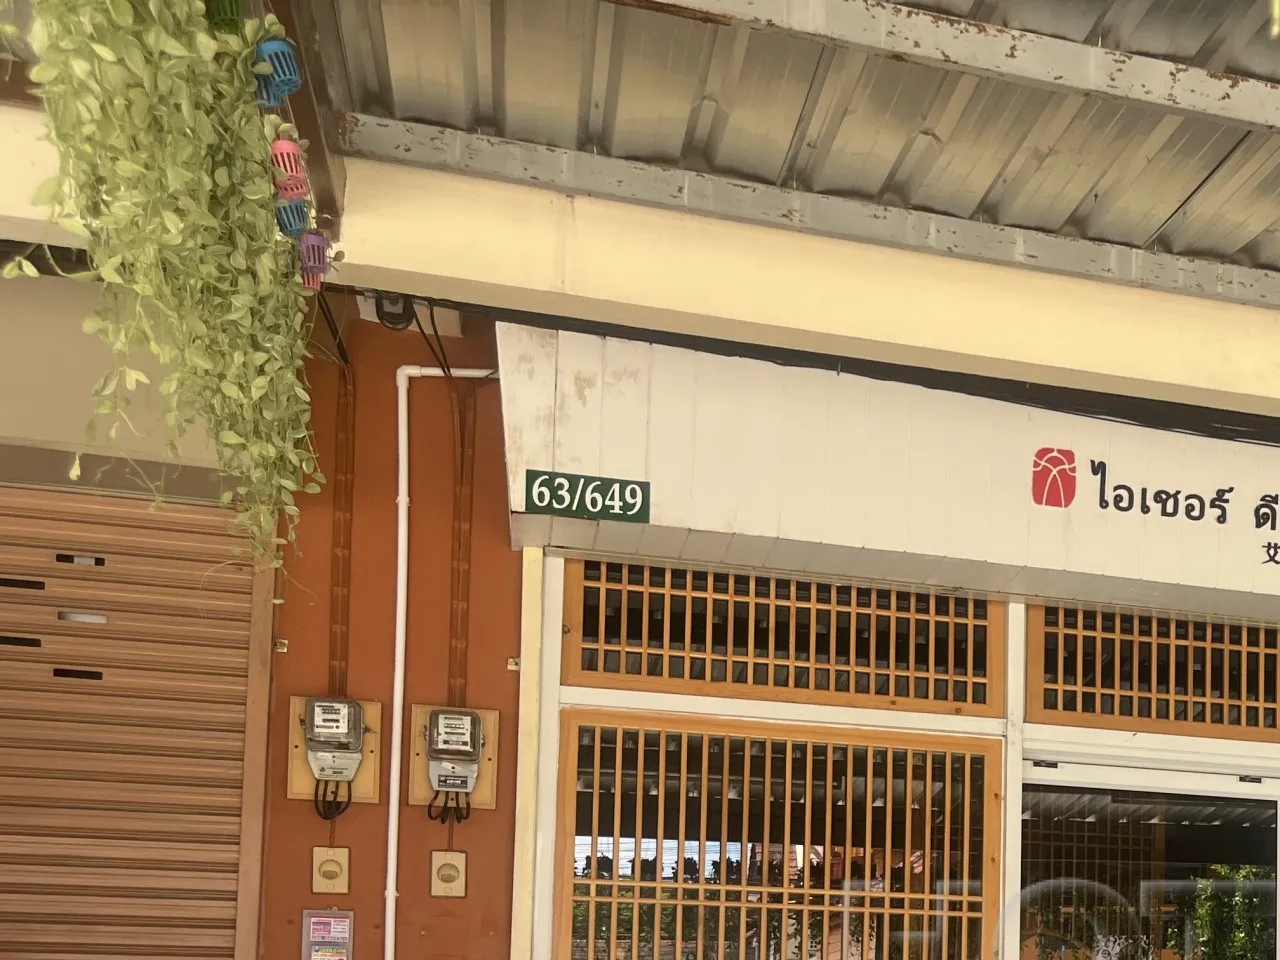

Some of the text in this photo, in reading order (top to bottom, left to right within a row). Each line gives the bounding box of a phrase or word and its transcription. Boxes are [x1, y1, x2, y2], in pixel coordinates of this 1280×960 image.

[530, 474, 644, 517] 63/649
[1089, 458, 1236, 525] ไอเชอร์
